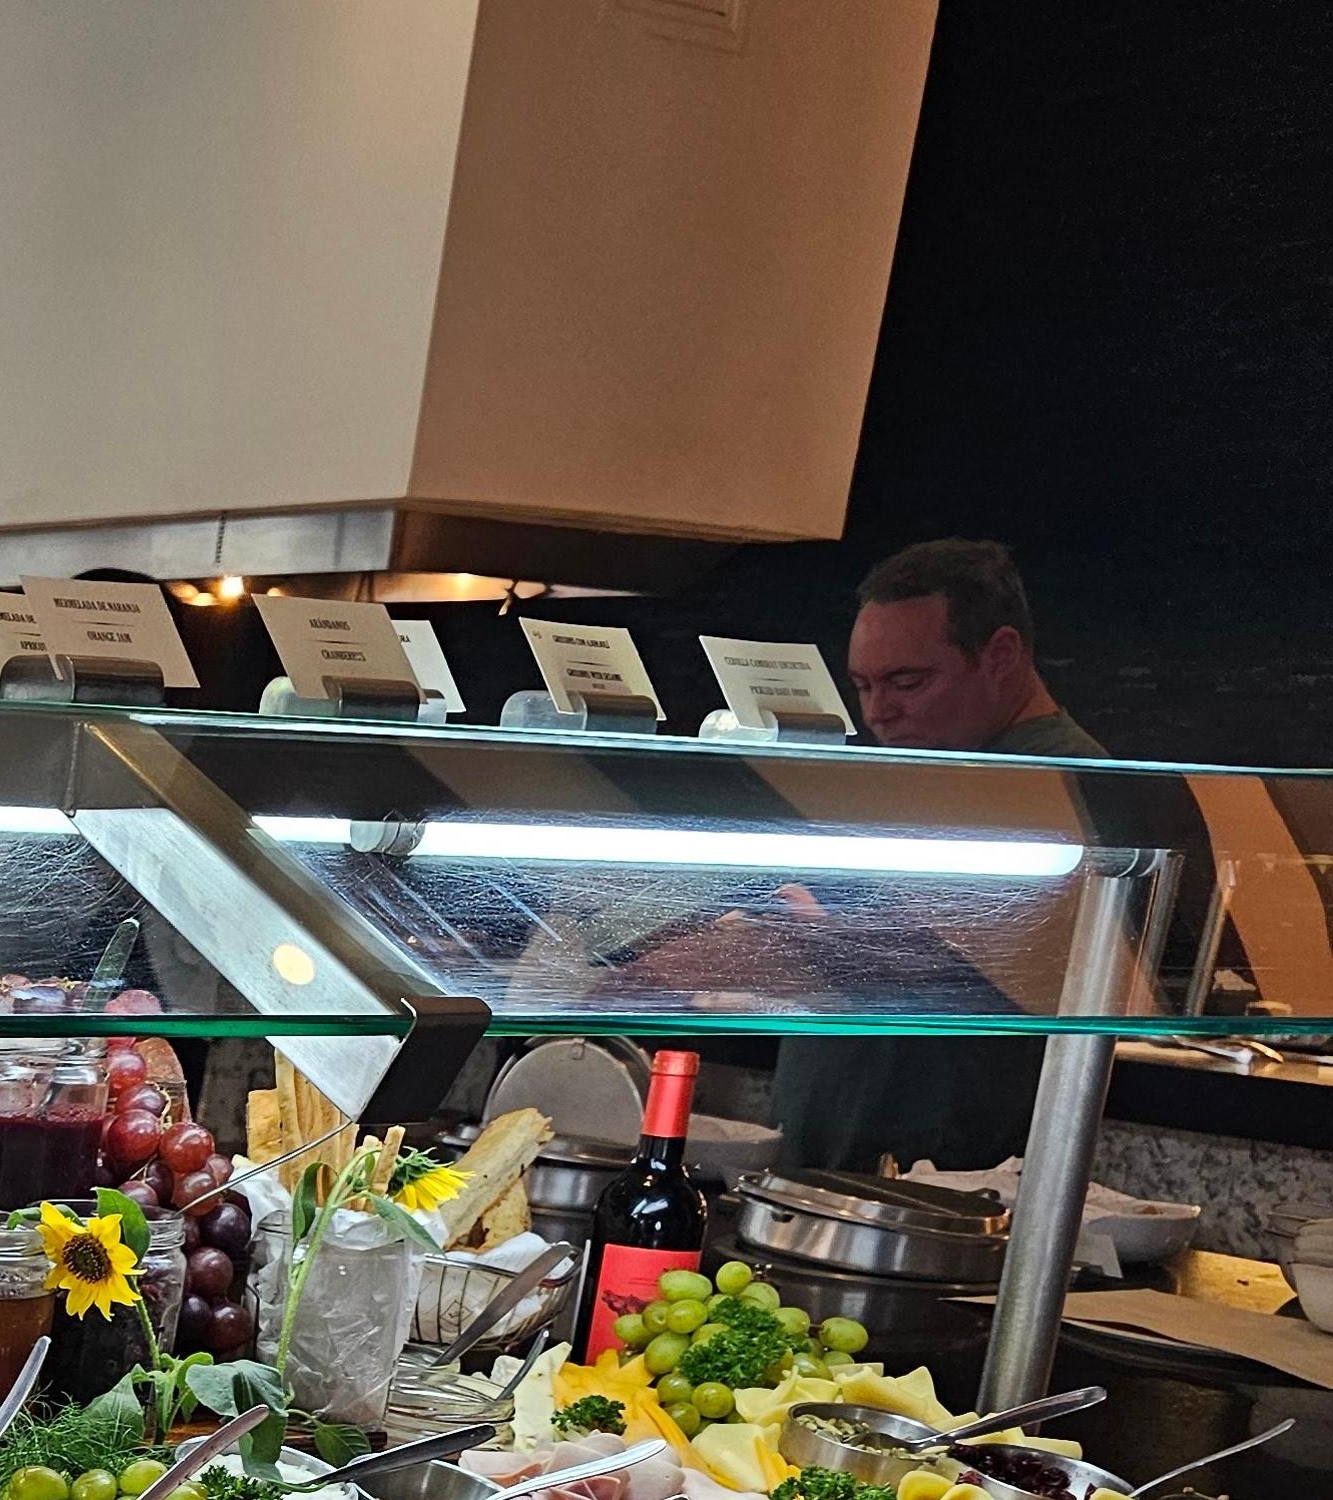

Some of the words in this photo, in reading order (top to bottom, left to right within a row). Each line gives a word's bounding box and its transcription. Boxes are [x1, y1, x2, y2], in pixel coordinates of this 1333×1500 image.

[53, 597, 98, 611] MERMELADA
[106, 602, 141, 614] NARANJA
[87, 631, 117, 643] ORANGE
[117, 633, 133, 644] JAM
